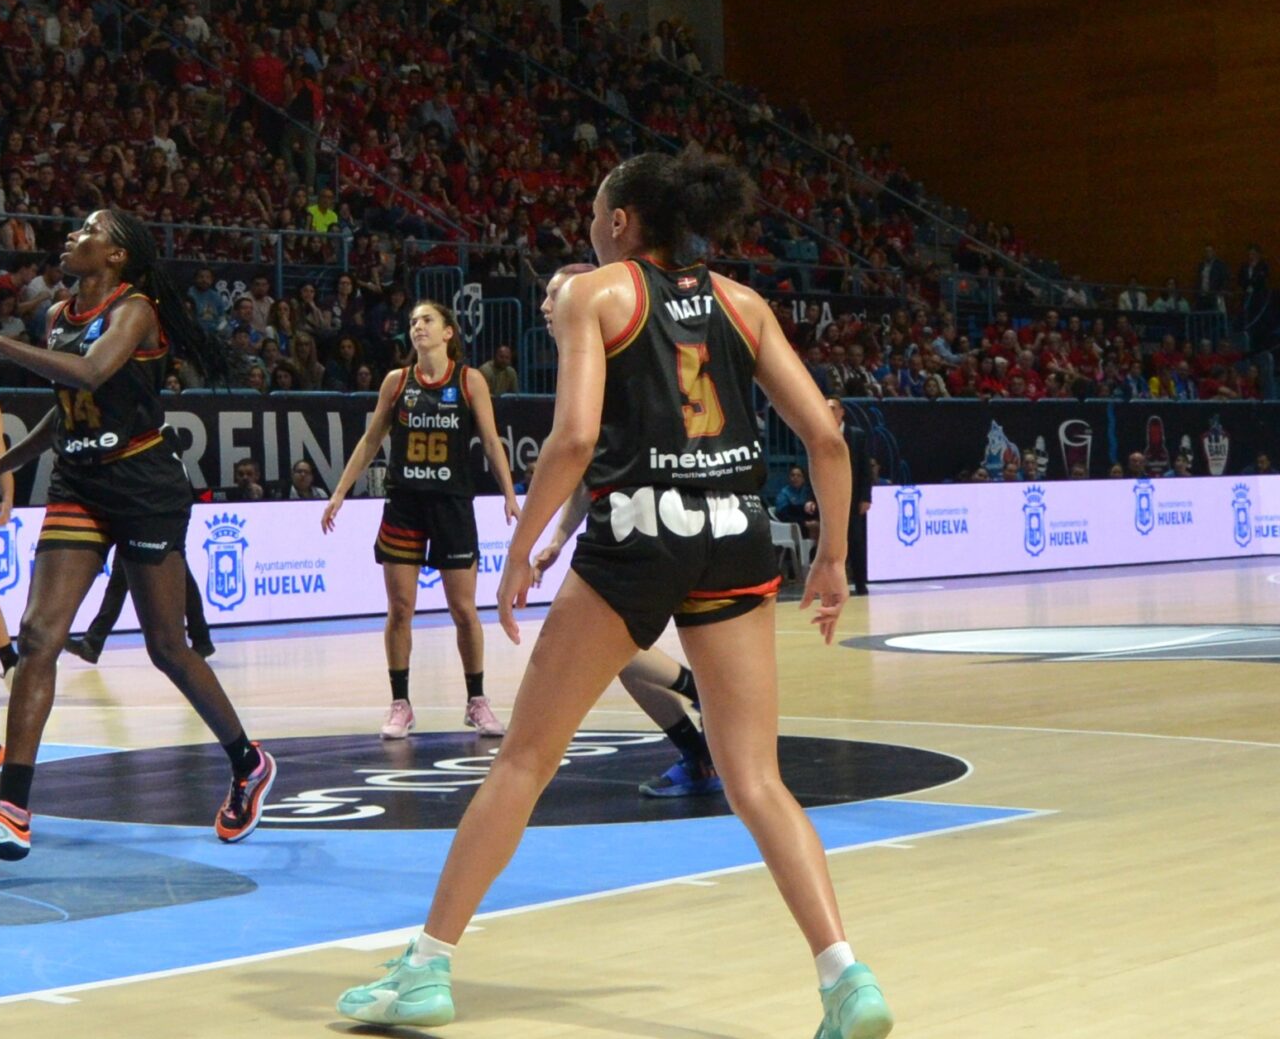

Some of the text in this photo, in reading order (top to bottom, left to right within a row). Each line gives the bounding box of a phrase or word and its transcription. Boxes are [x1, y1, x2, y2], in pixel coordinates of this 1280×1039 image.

[677, 342, 727, 439] 5
[408, 412, 460, 430] lointek
[406, 430, 449, 464] 66
[403, 466, 437, 480] bbk
[671, 463, 754, 480] Positive digital flow
[1157, 511, 1193, 526] HUELVA
[925, 519, 968, 536] HUELVA
[1049, 530, 1089, 547] HUELVA
[254, 557, 326, 572] Ayuntamiento de
[254, 574, 326, 596] HUELVA
